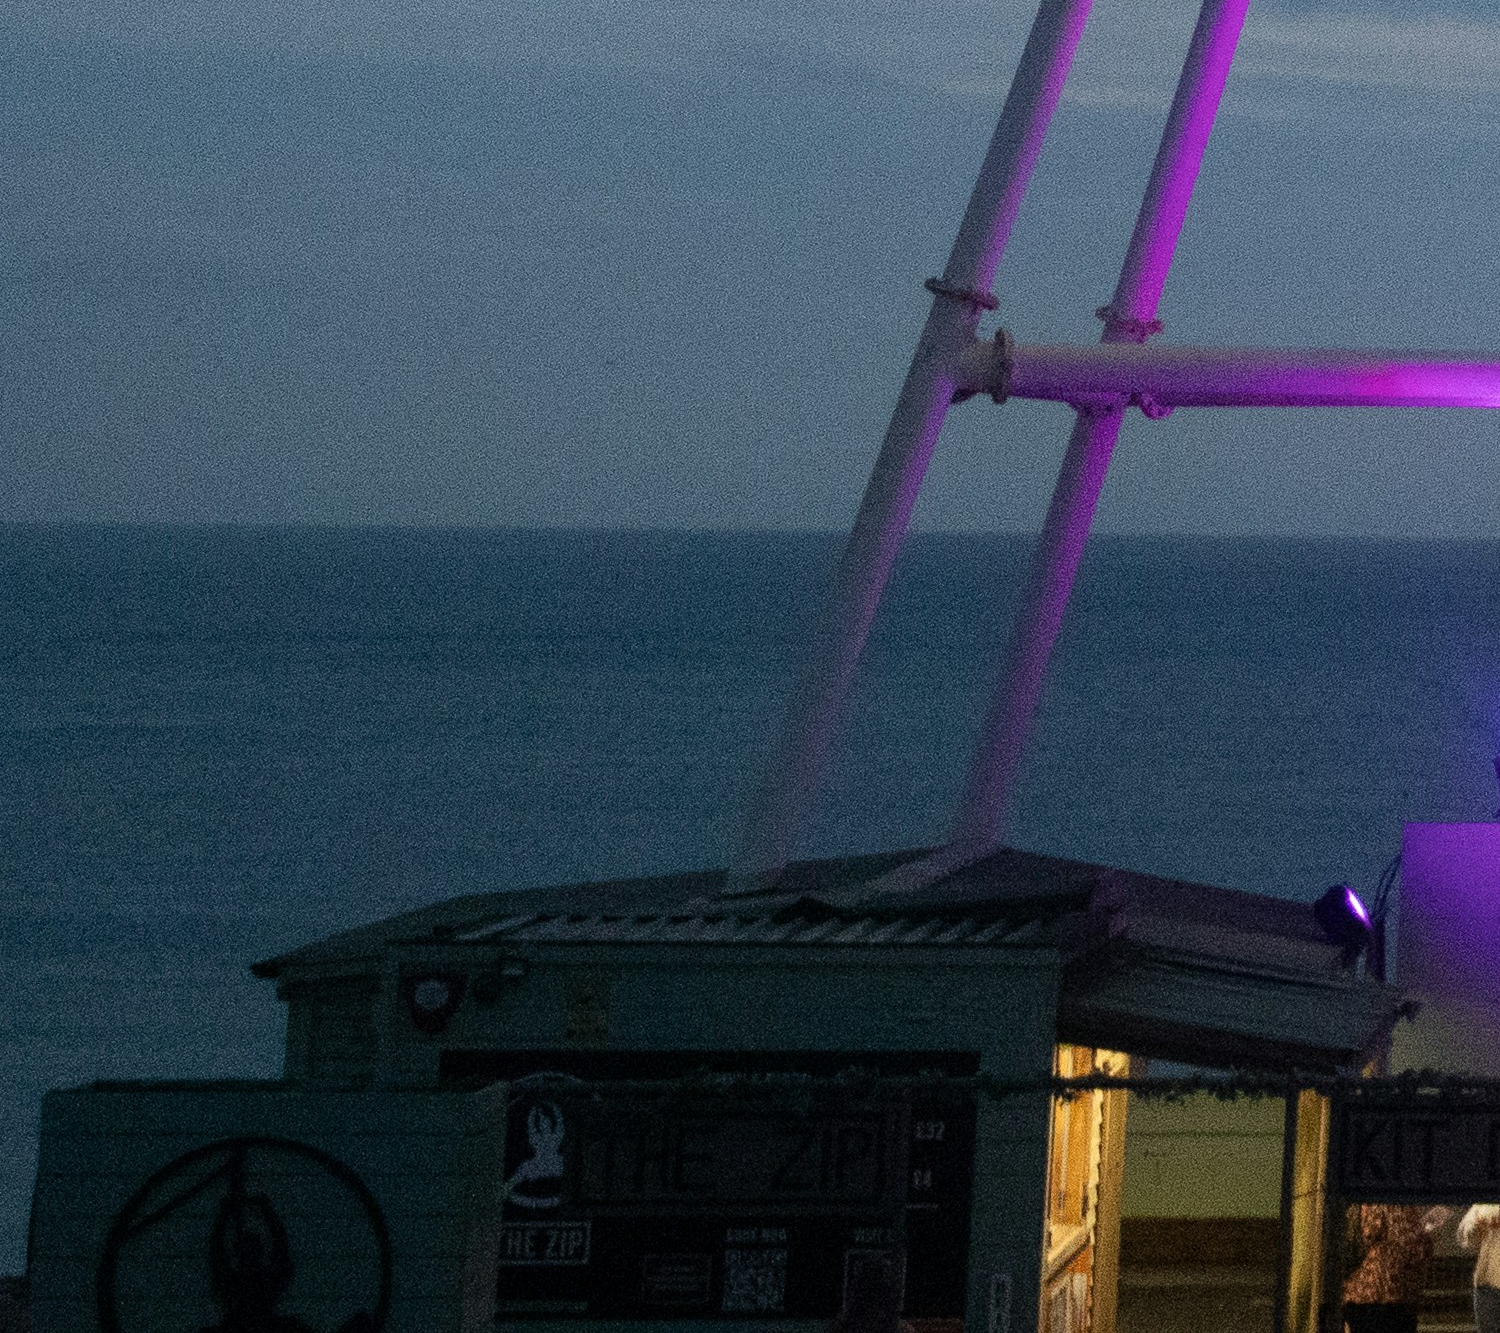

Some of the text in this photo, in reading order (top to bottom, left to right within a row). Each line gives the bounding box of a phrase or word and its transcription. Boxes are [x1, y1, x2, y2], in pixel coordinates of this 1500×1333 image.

[588, 1122, 873, 1193] THE ZIP
[1351, 1118, 1448, 1183] KIT
[545, 1229, 584, 1258] ZIP
